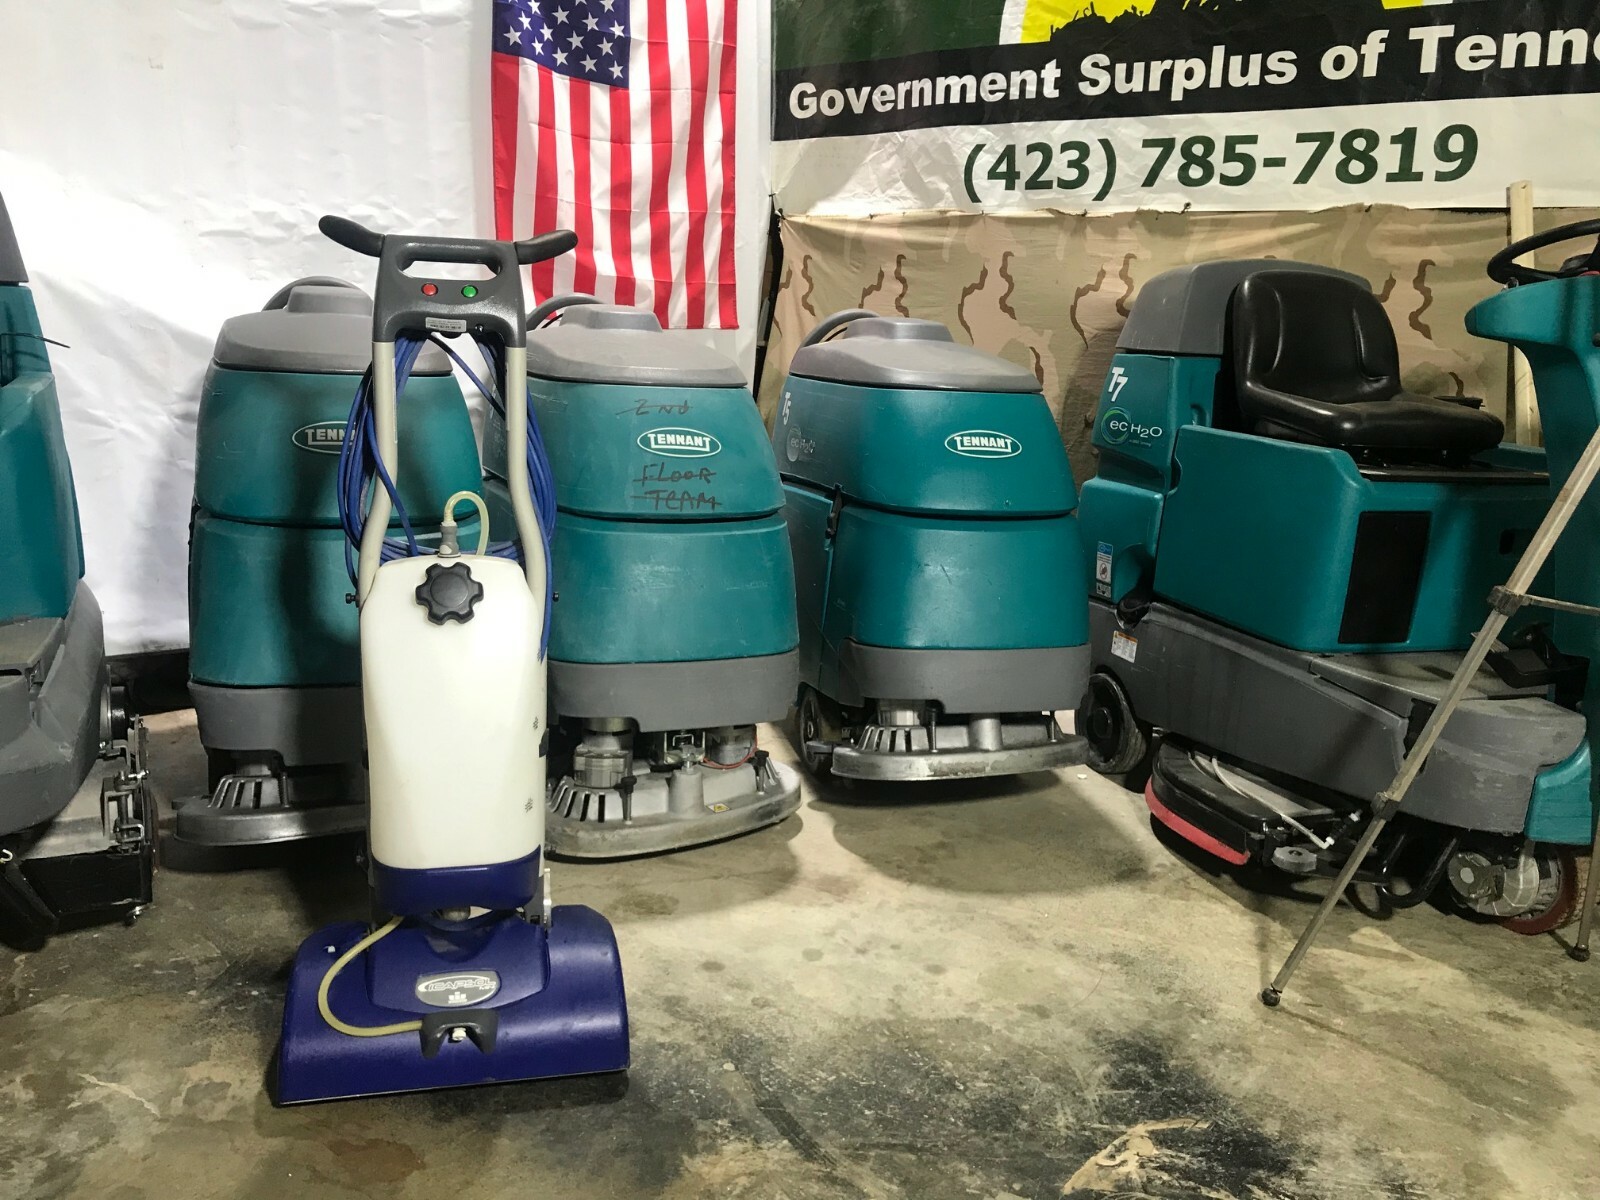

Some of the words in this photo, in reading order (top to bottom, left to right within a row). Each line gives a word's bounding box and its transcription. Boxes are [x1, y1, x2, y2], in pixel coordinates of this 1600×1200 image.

[789, 58, 1062, 119] Government
[1077, 44, 1299, 102] Surplus
[1320, 29, 1390, 80] of
[1408, 24, 1600, 74] Tenn
[963, 138, 1117, 203] (423)
[1140, 123, 1479, 188] 785-7819
[647, 433, 712, 452] TENNANT
[954, 435, 1013, 453] TENNANT
